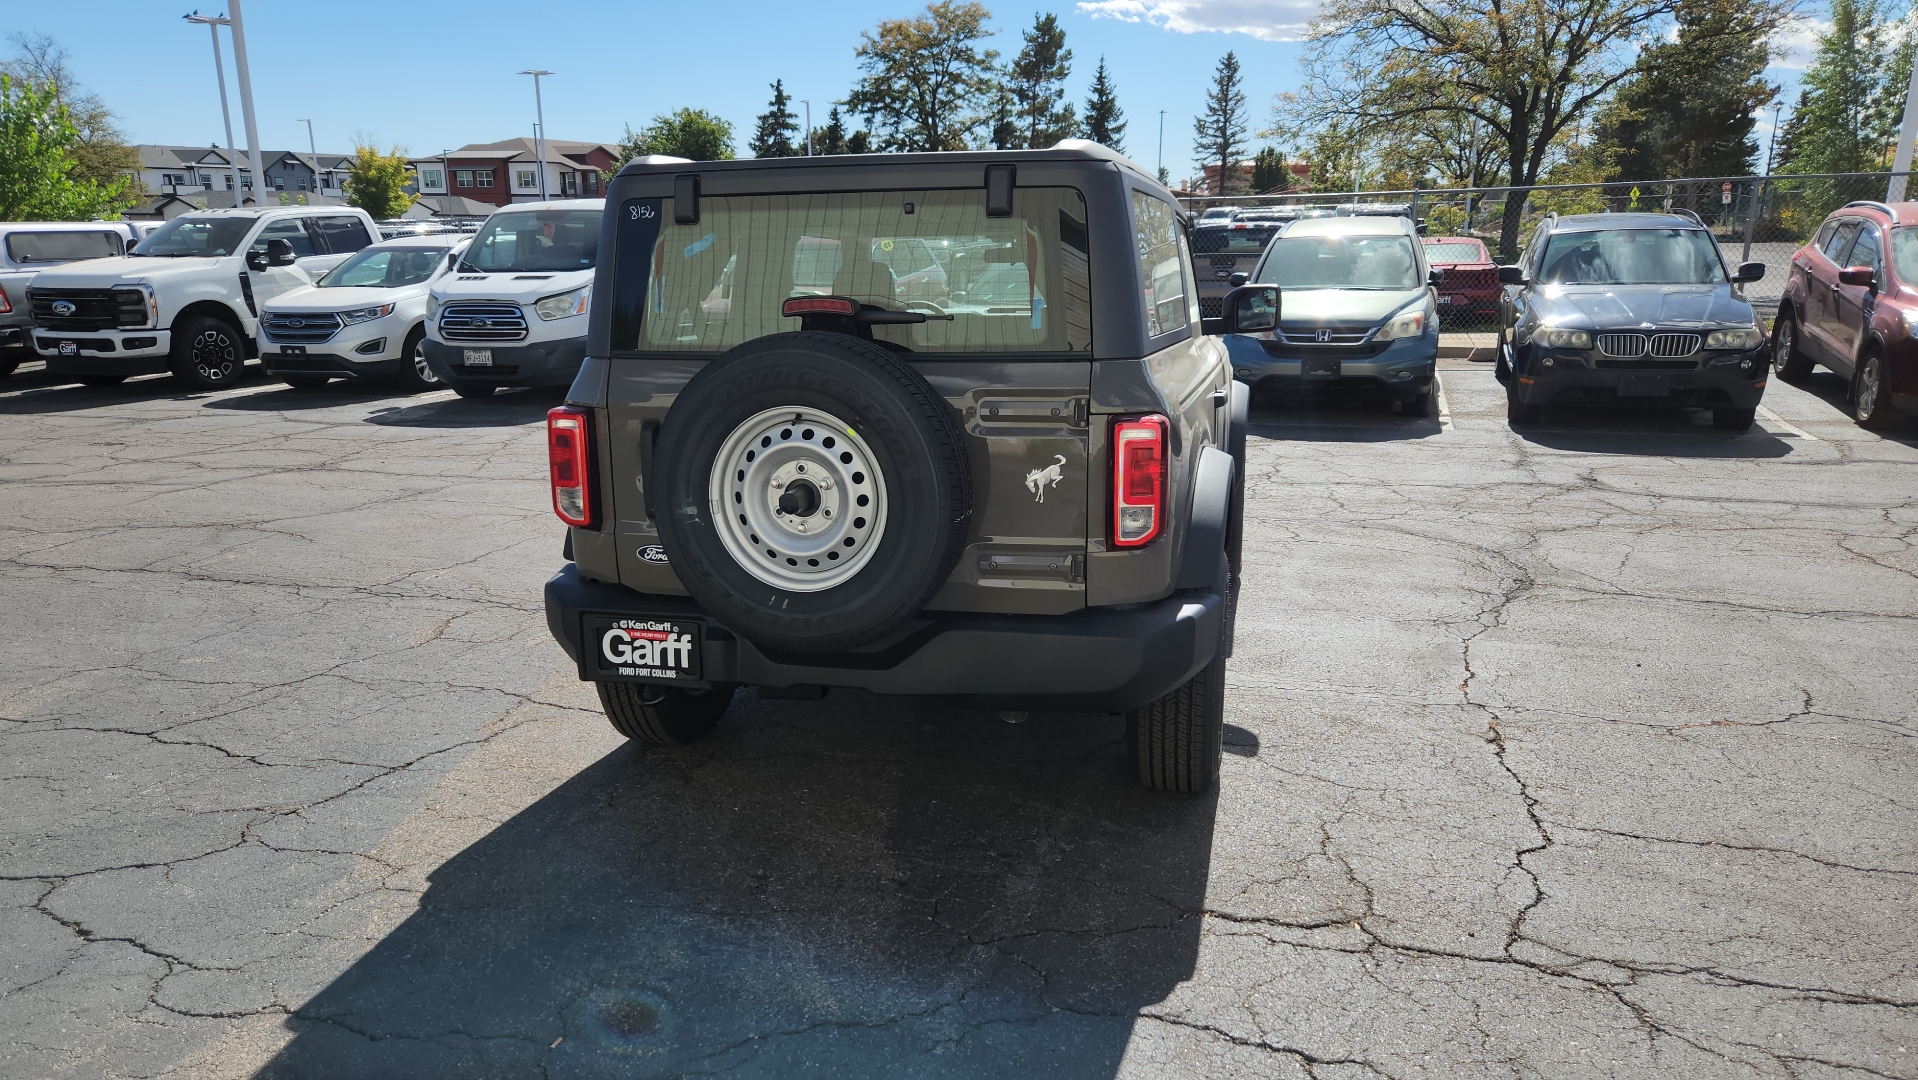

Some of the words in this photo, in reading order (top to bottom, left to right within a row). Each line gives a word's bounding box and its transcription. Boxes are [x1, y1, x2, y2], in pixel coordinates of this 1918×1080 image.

[602, 628, 692, 668] Garff
[619, 667, 635, 676] FORD
[636, 668, 651, 677] FORT
[651, 669, 676, 679] COLLINS
